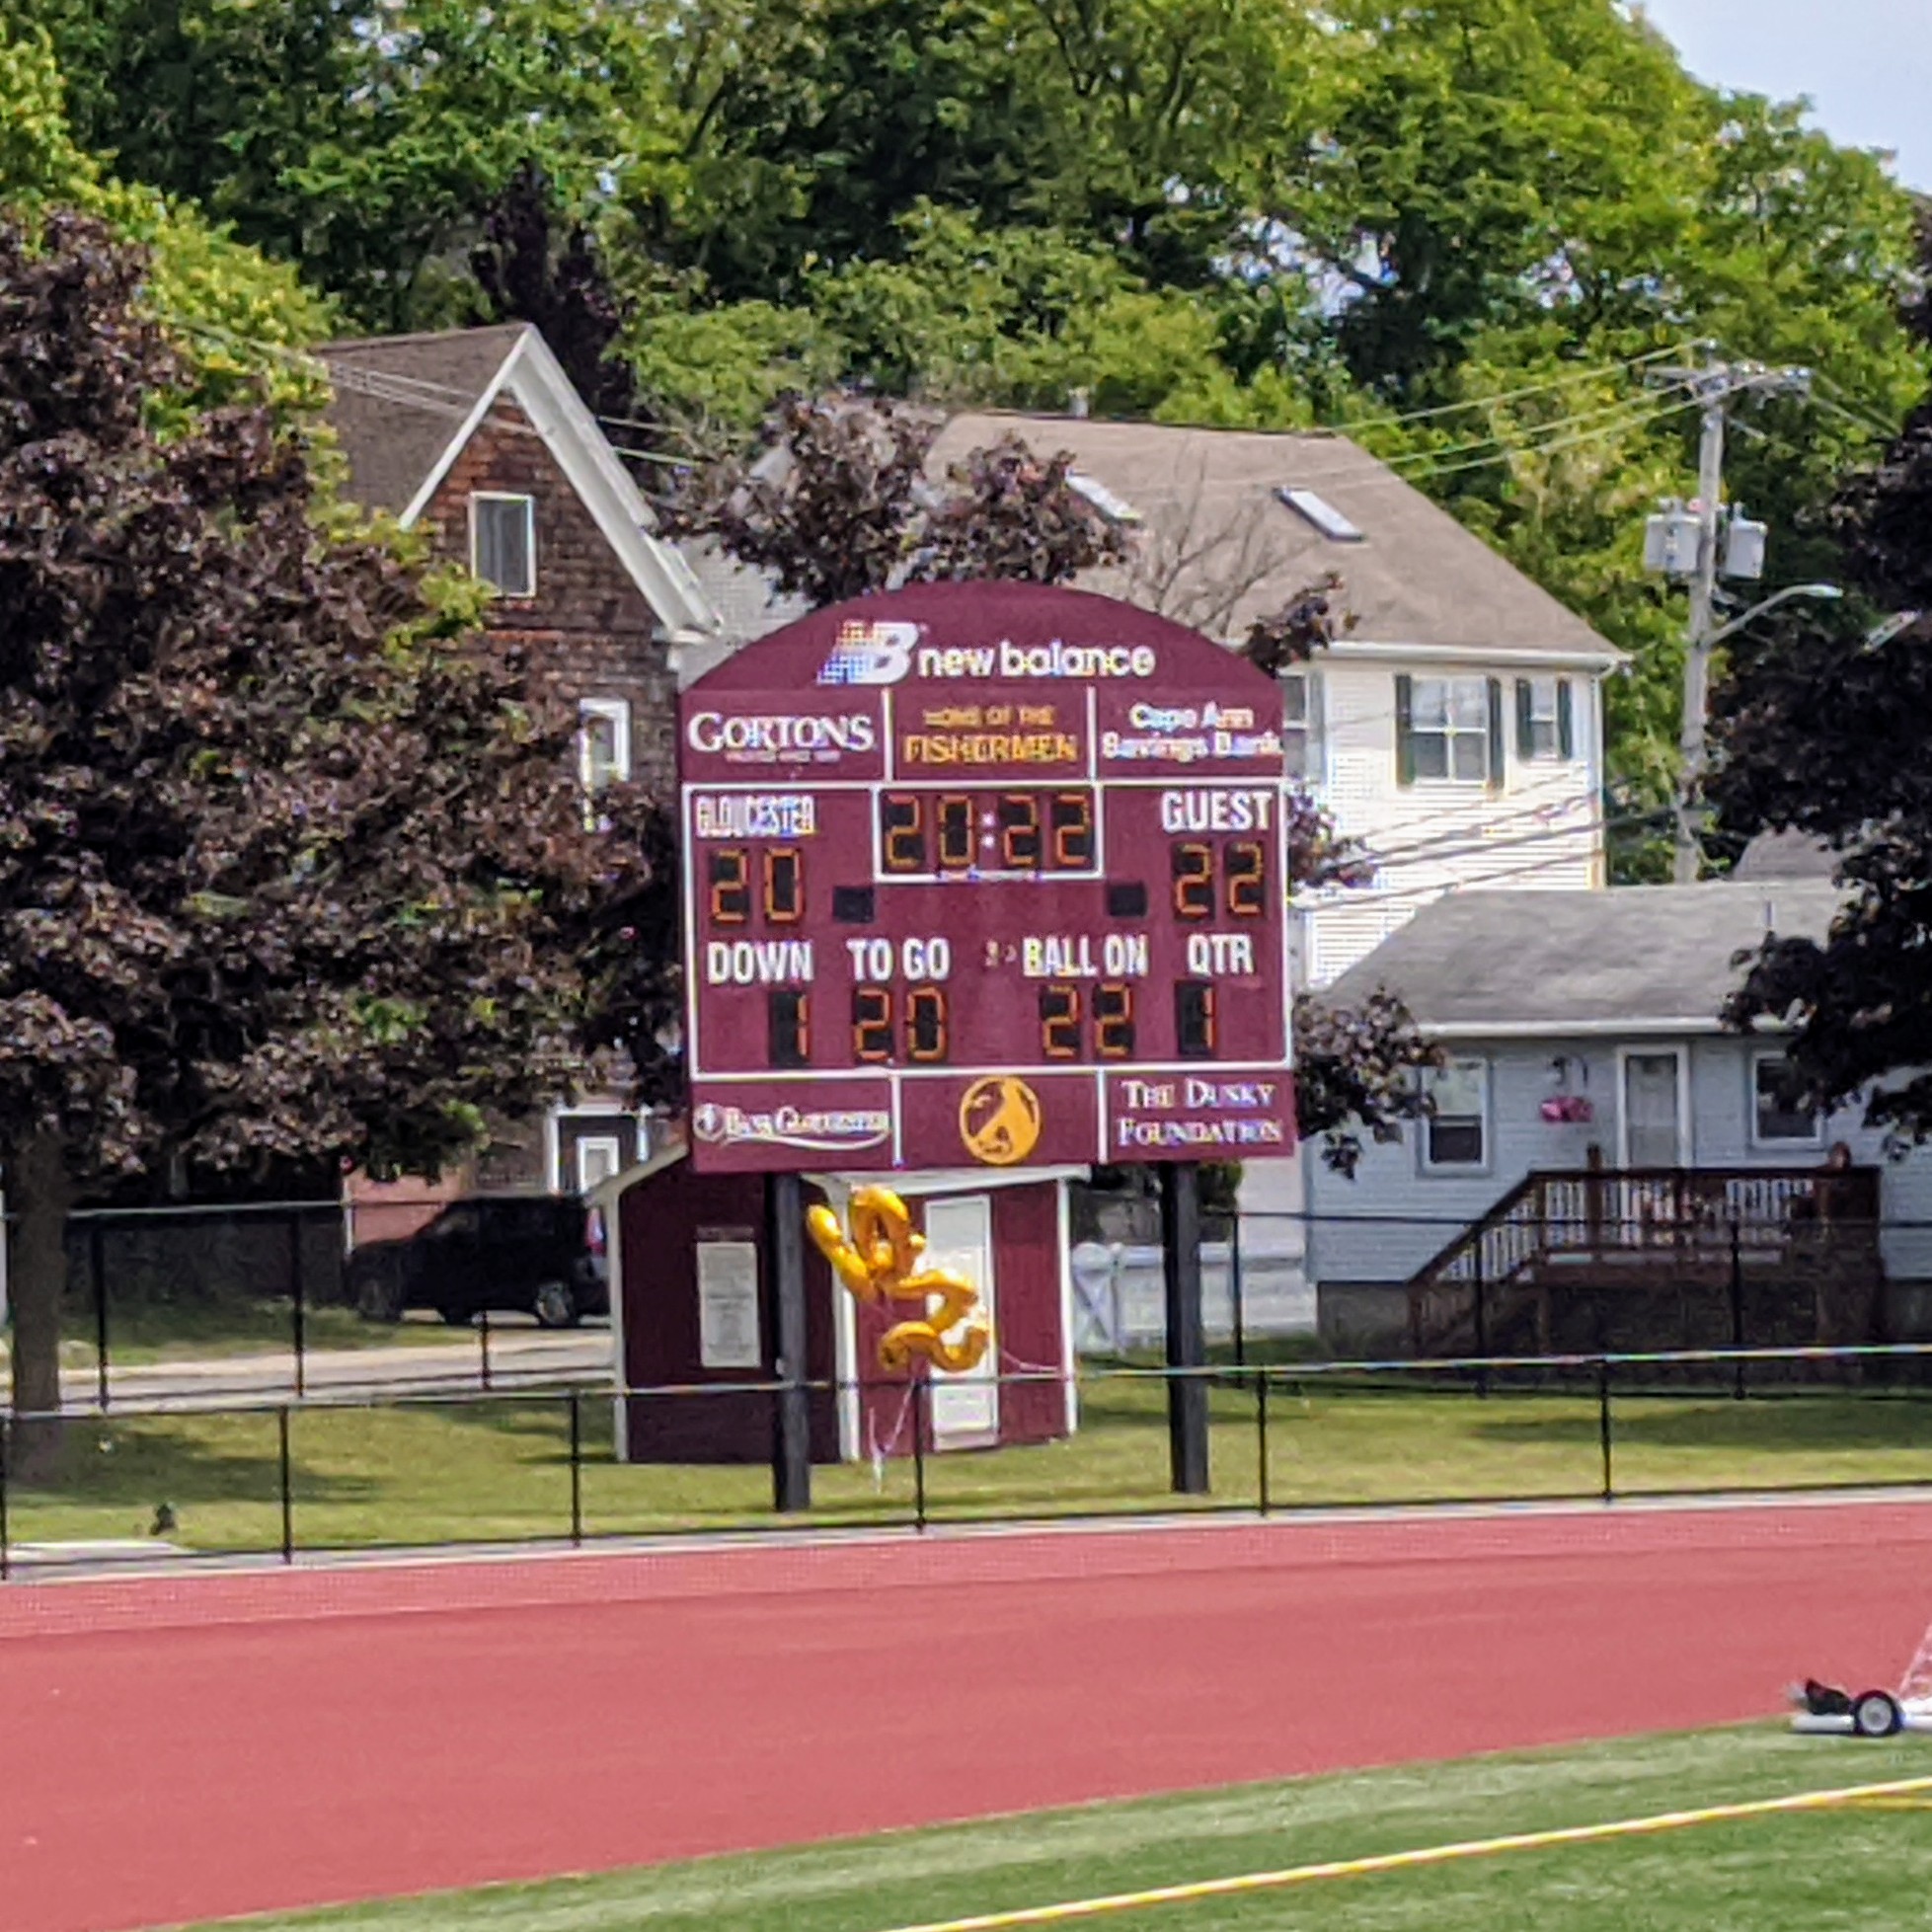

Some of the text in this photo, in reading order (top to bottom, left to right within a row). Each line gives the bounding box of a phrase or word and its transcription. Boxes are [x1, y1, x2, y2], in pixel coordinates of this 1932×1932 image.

[918, 639, 1156, 676] new balance
[1161, 790, 1274, 833] GUEST
[711, 848, 803, 923] 20
[1175, 841, 1264, 916] 22
[707, 940, 814, 984] DOWN
[845, 937, 951, 981] TO GO
[1022, 934, 1150, 977] BALL ON
[1188, 933, 1255, 975] QTR
[853, 988, 949, 1062] 20
[1043, 983, 1132, 1058] 22
